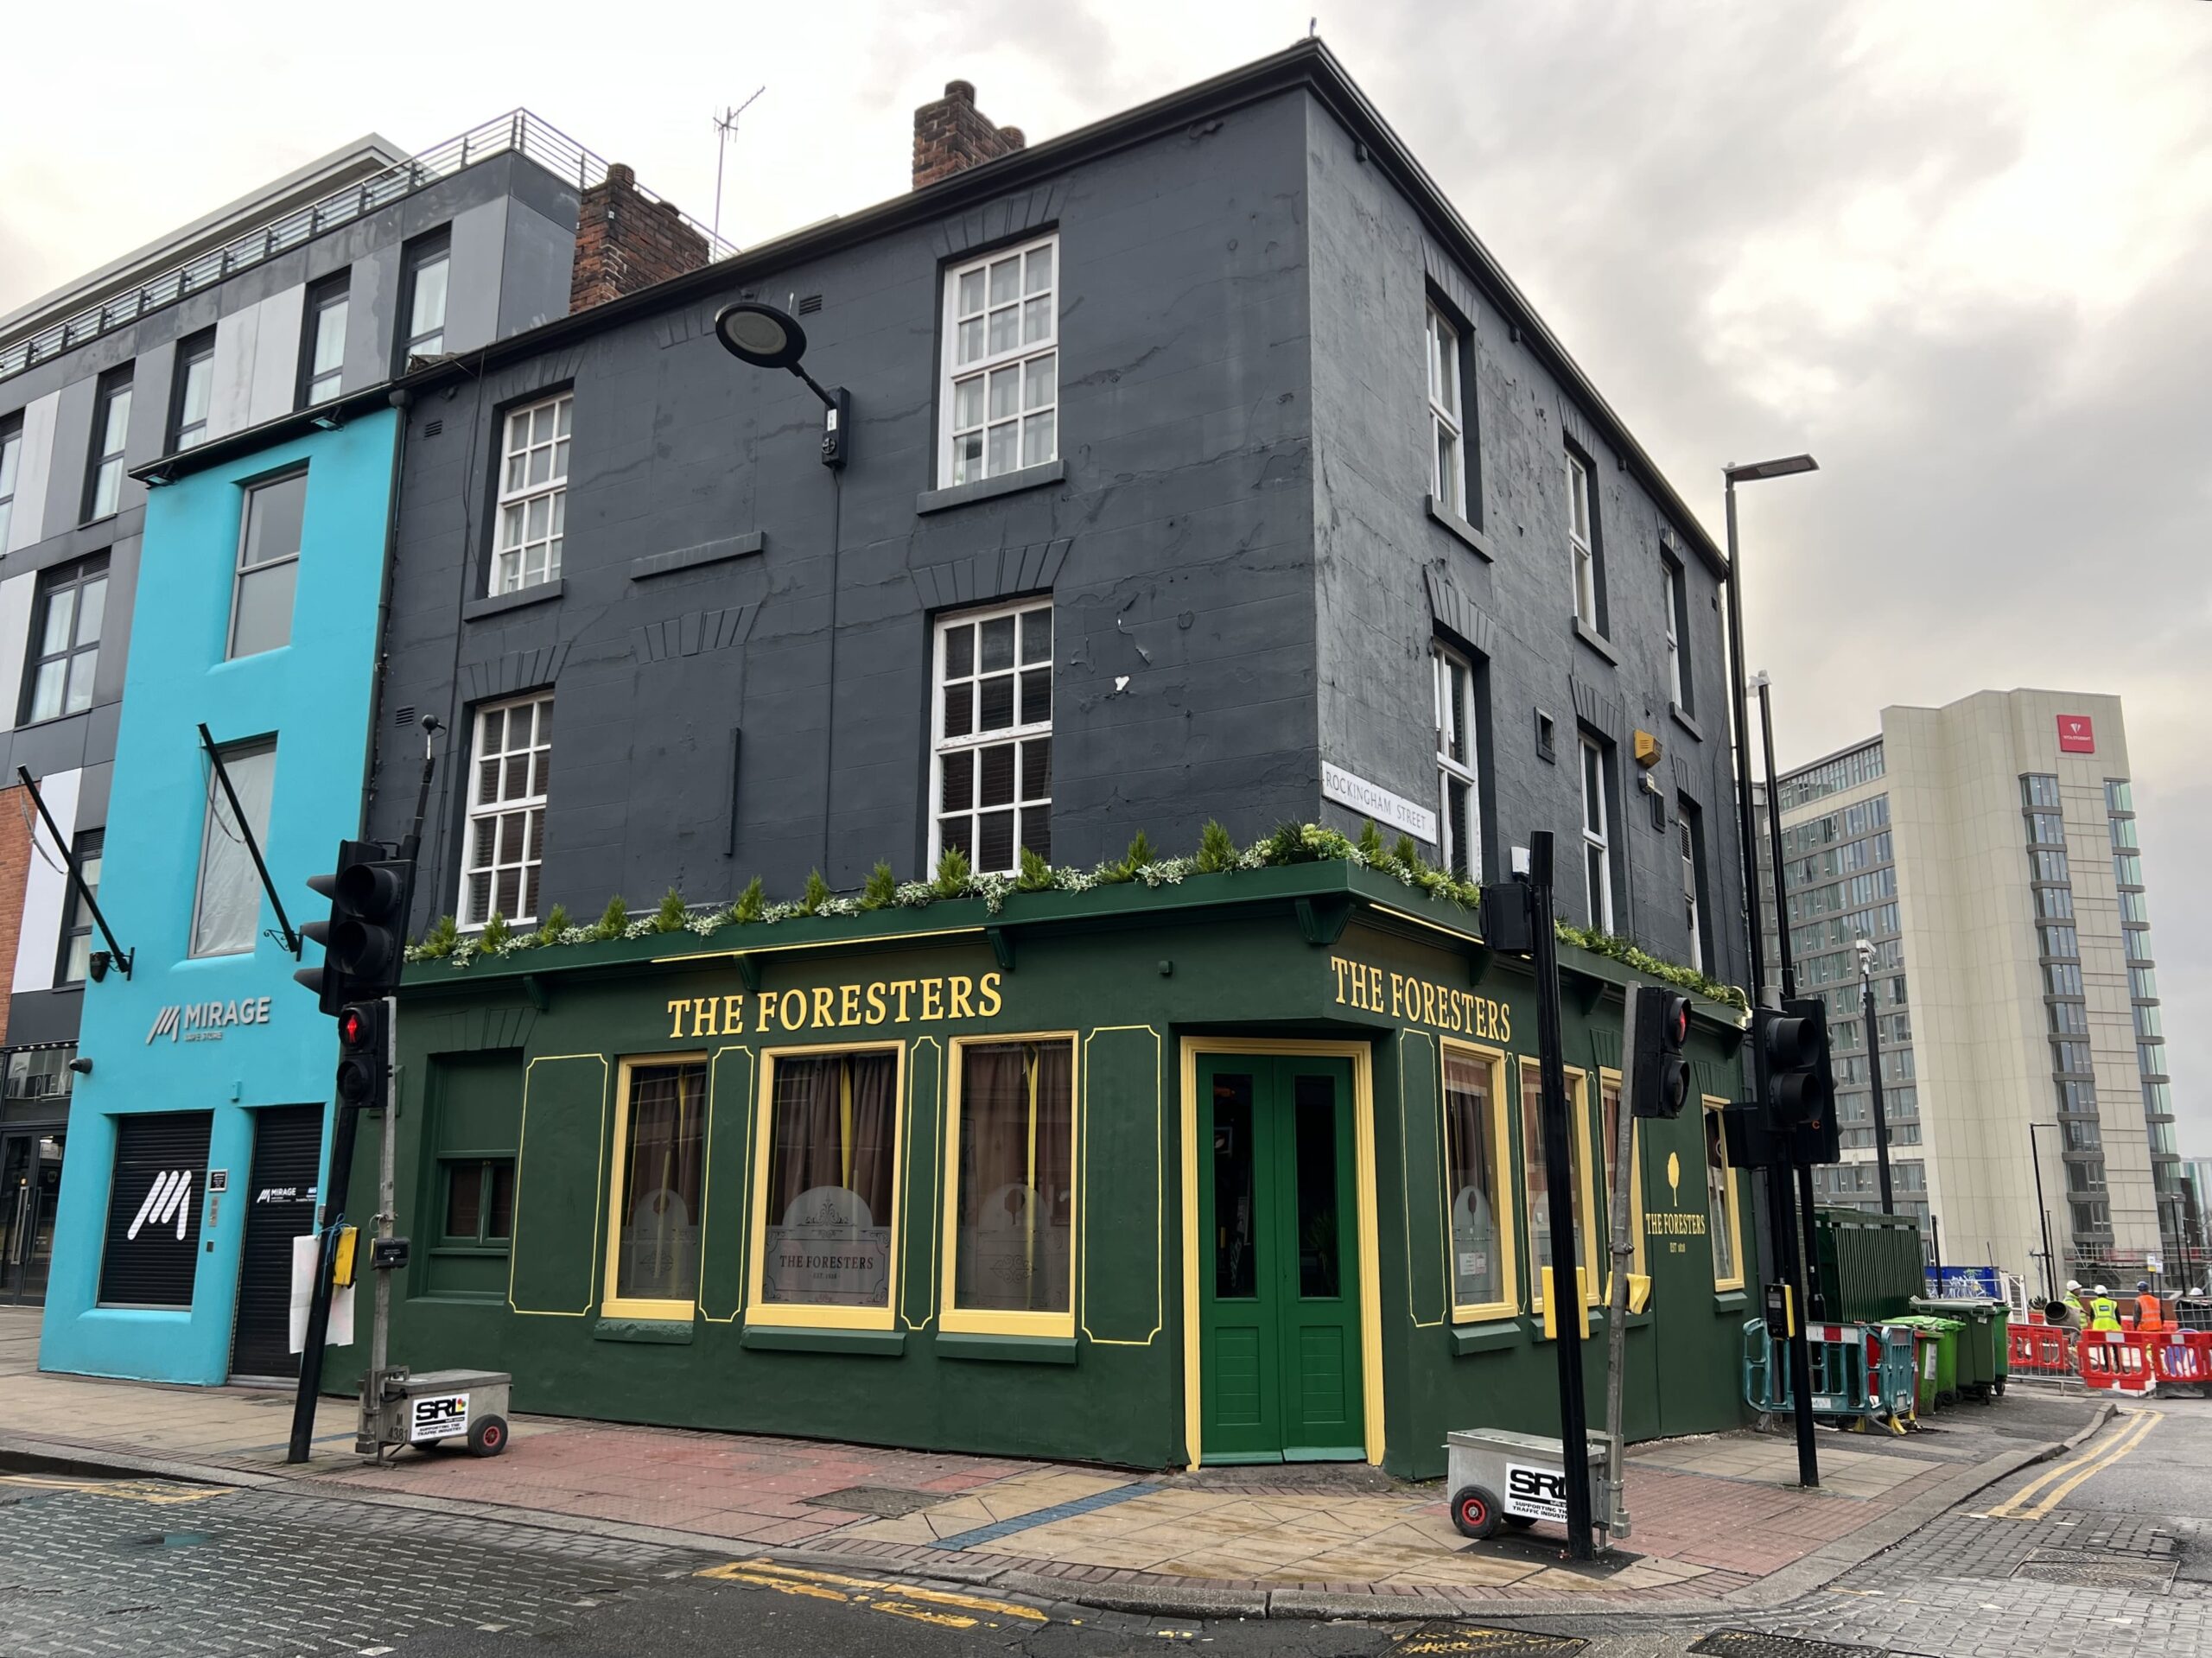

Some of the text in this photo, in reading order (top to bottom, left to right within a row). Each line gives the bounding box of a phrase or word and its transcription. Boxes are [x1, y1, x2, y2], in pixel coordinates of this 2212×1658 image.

[1325, 771, 1426, 830] ROCKINGHAM STREET
[668, 972, 1002, 1039] THE FORESTERS
[1331, 956, 1511, 1043] THE FORESTERS
[184, 996, 271, 1029] MIRAGE
[270, 1187, 296, 1196] MIRAGE
[1645, 1213, 1706, 1235] THE FORESTERS
[779, 1255, 874, 1270] THE FORESTERS
[416, 1398, 465, 1421] SRL
[389, 1426, 409, 1442] 4381
[1513, 1505, 1539, 1515] TRAFFIC
[1515, 1501, 1556, 1512] SUPPORTING
